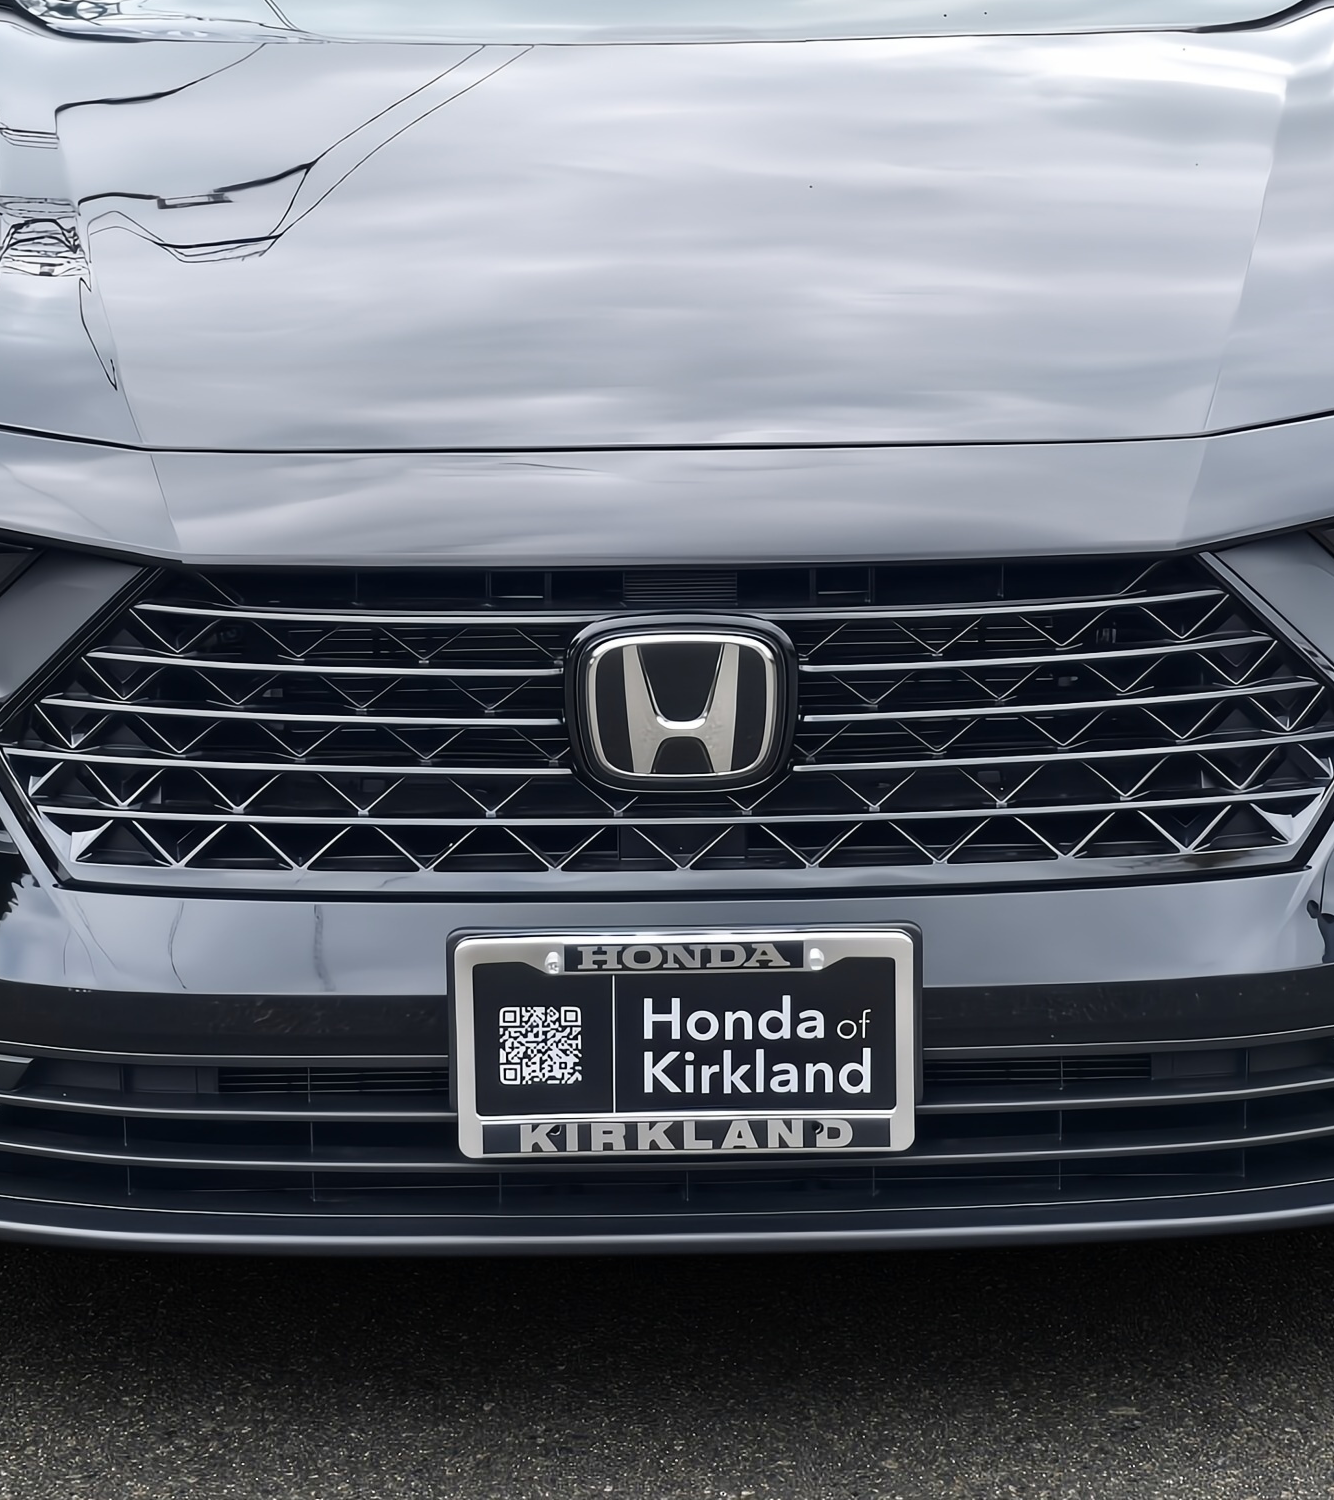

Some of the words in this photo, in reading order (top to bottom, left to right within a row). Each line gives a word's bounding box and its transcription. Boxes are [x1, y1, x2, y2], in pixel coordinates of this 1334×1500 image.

[577, 943, 790, 970] HONDA
[643, 995, 824, 1041] Honda
[836, 1009, 871, 1040] of
[643, 1048, 871, 1094] Kirkland
[520, 1119, 854, 1153] KIRKLAND
